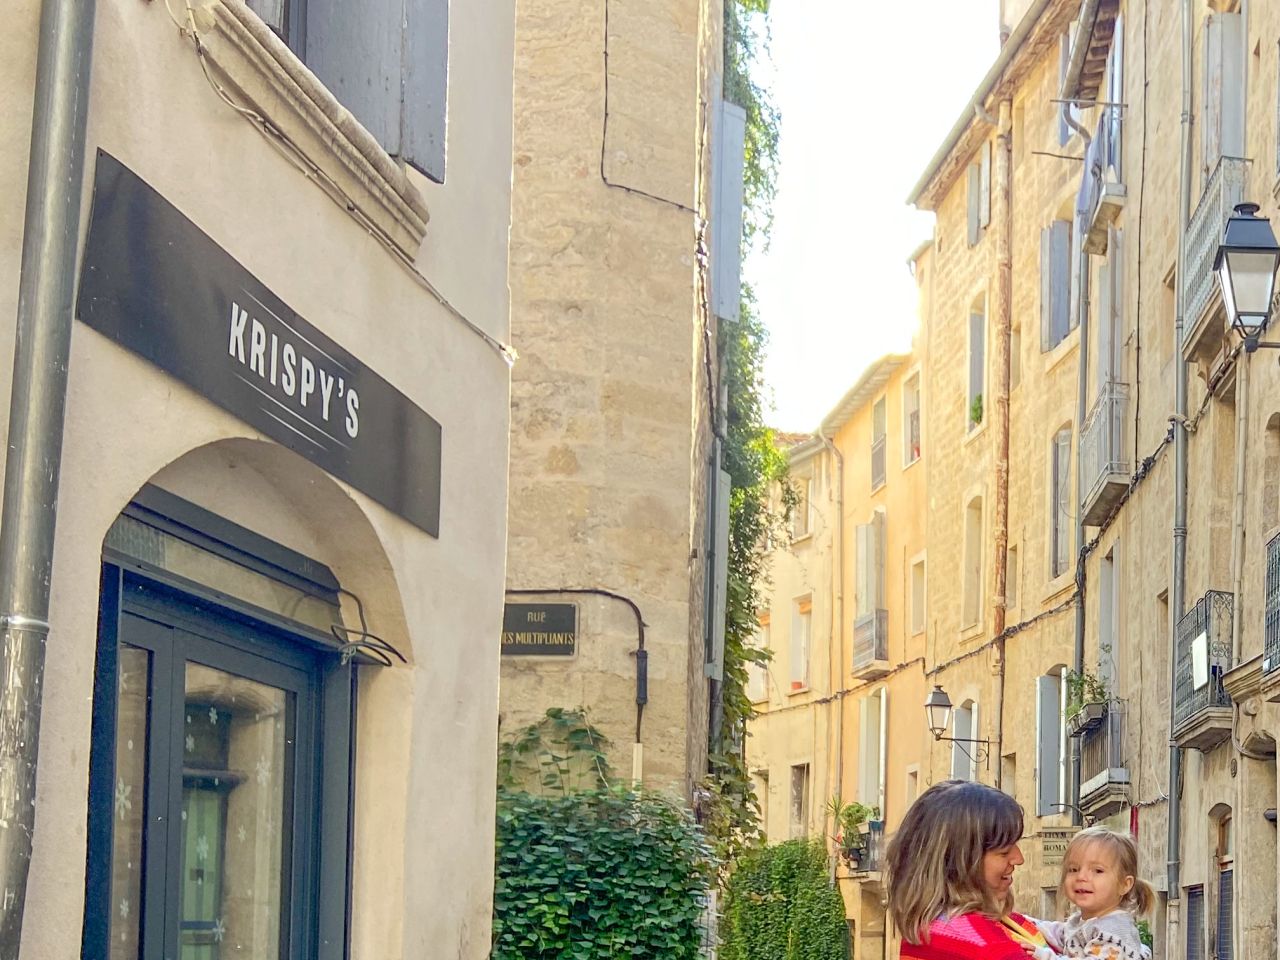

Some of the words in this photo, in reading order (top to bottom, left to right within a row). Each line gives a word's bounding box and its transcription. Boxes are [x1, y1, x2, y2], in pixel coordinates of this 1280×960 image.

[229, 301, 359, 438] KRISPY'S
[527, 611, 546, 622] RUE
[515, 632, 574, 645] MULTIPLIANTS
